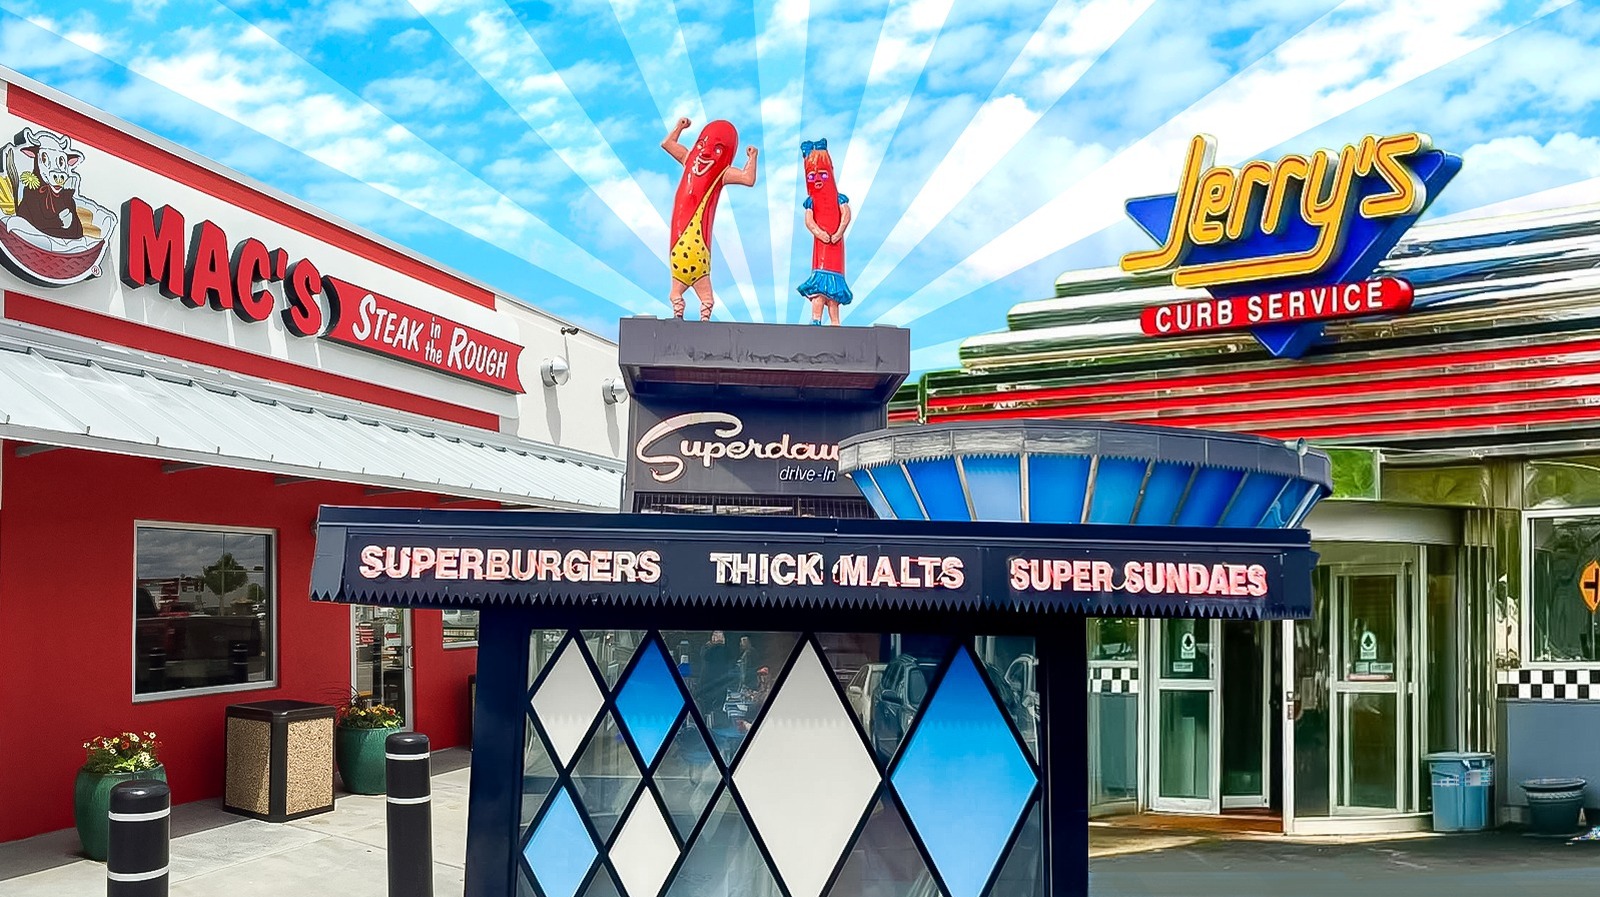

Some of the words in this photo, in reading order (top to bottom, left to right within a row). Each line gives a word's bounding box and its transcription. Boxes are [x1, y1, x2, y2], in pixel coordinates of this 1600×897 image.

[1119, 132, 1430, 288] Jerry's
[120, 196, 322, 338] MAC'S
[352, 293, 424, 352] STEAK
[430, 317, 442, 339] in
[1155, 300, 1234, 332] CURB
[1248, 281, 1384, 321] SERVICE
[425, 340, 443, 365] the
[447, 327, 509, 379] ROUGH
[359, 545, 662, 583] SUPERBURGERS
[709, 552, 824, 586] THICK
[838, 555, 965, 589] MALTS
[1010, 558, 1113, 592] SUPER
[1124, 561, 1268, 597] SUNDAES
